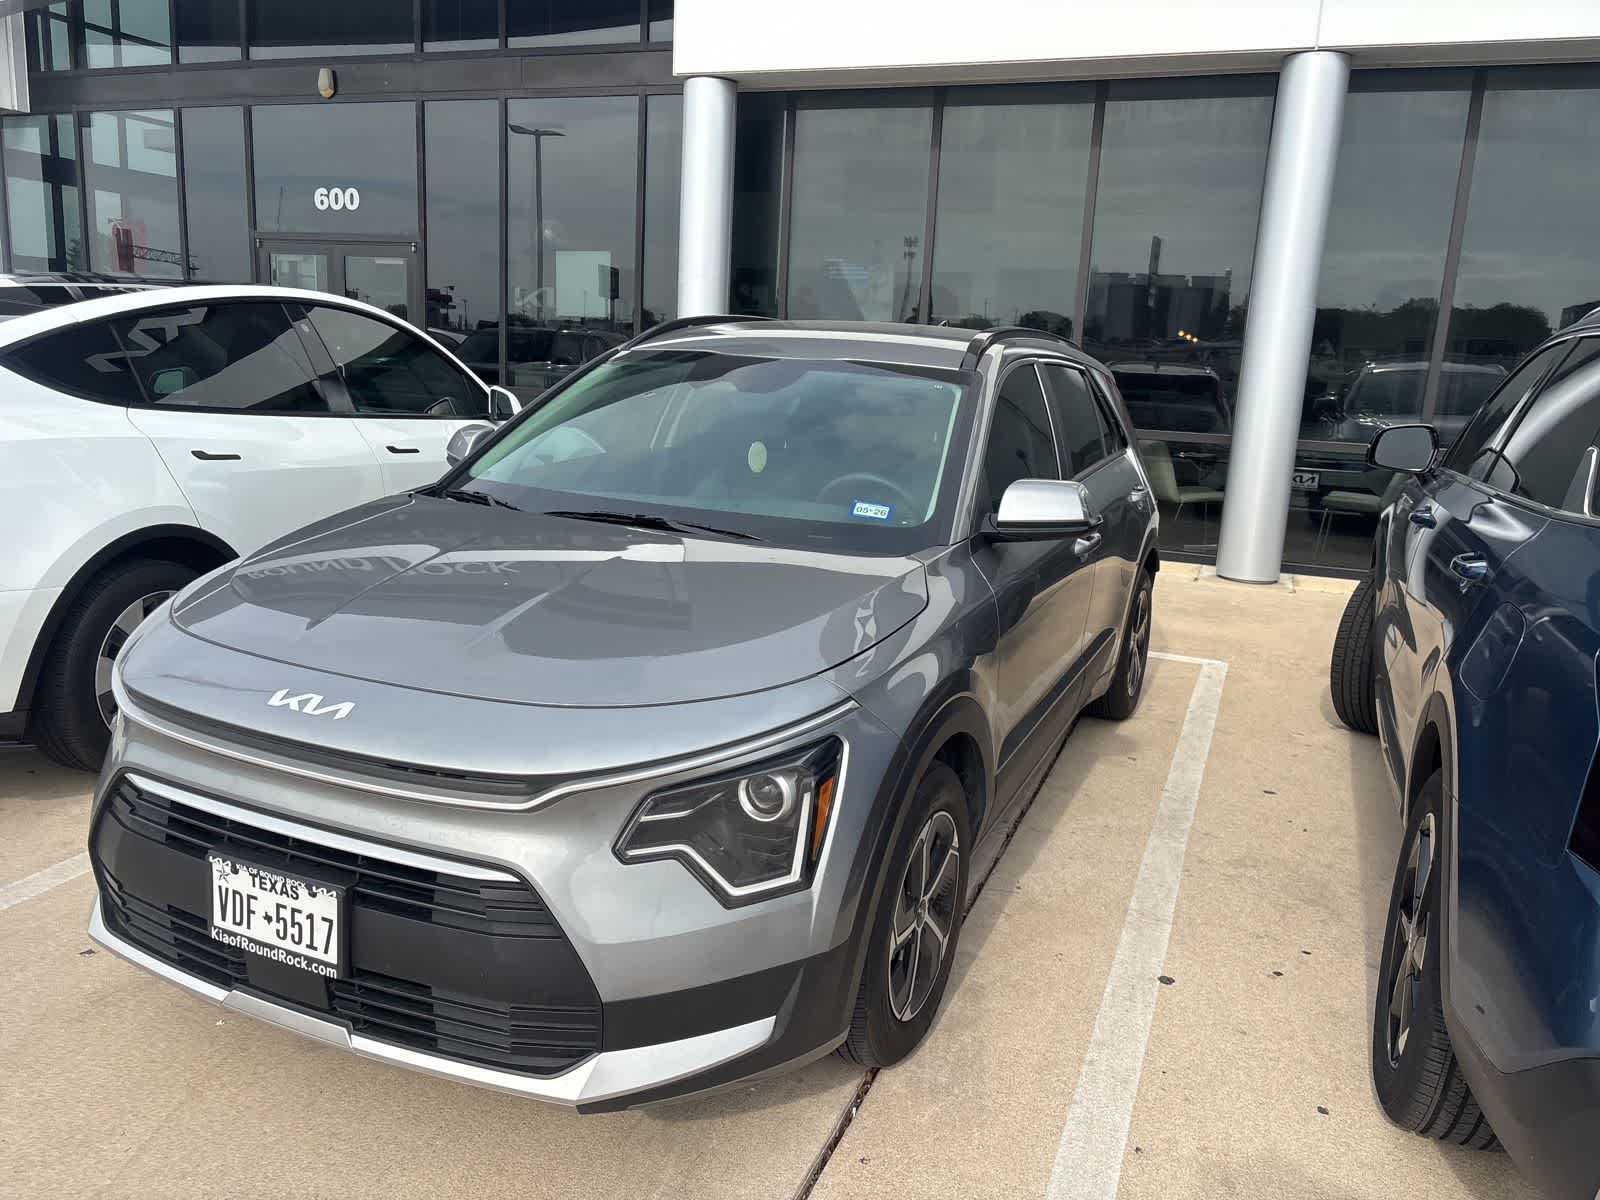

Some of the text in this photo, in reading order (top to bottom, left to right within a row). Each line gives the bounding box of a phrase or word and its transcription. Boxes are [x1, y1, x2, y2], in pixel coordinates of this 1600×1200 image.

[314, 187, 360, 211] 600
[248, 873, 300, 901] TEXAS
[218, 885, 334, 955] VDF 5517
[210, 926, 338, 980] KiaofRoundRock.com
